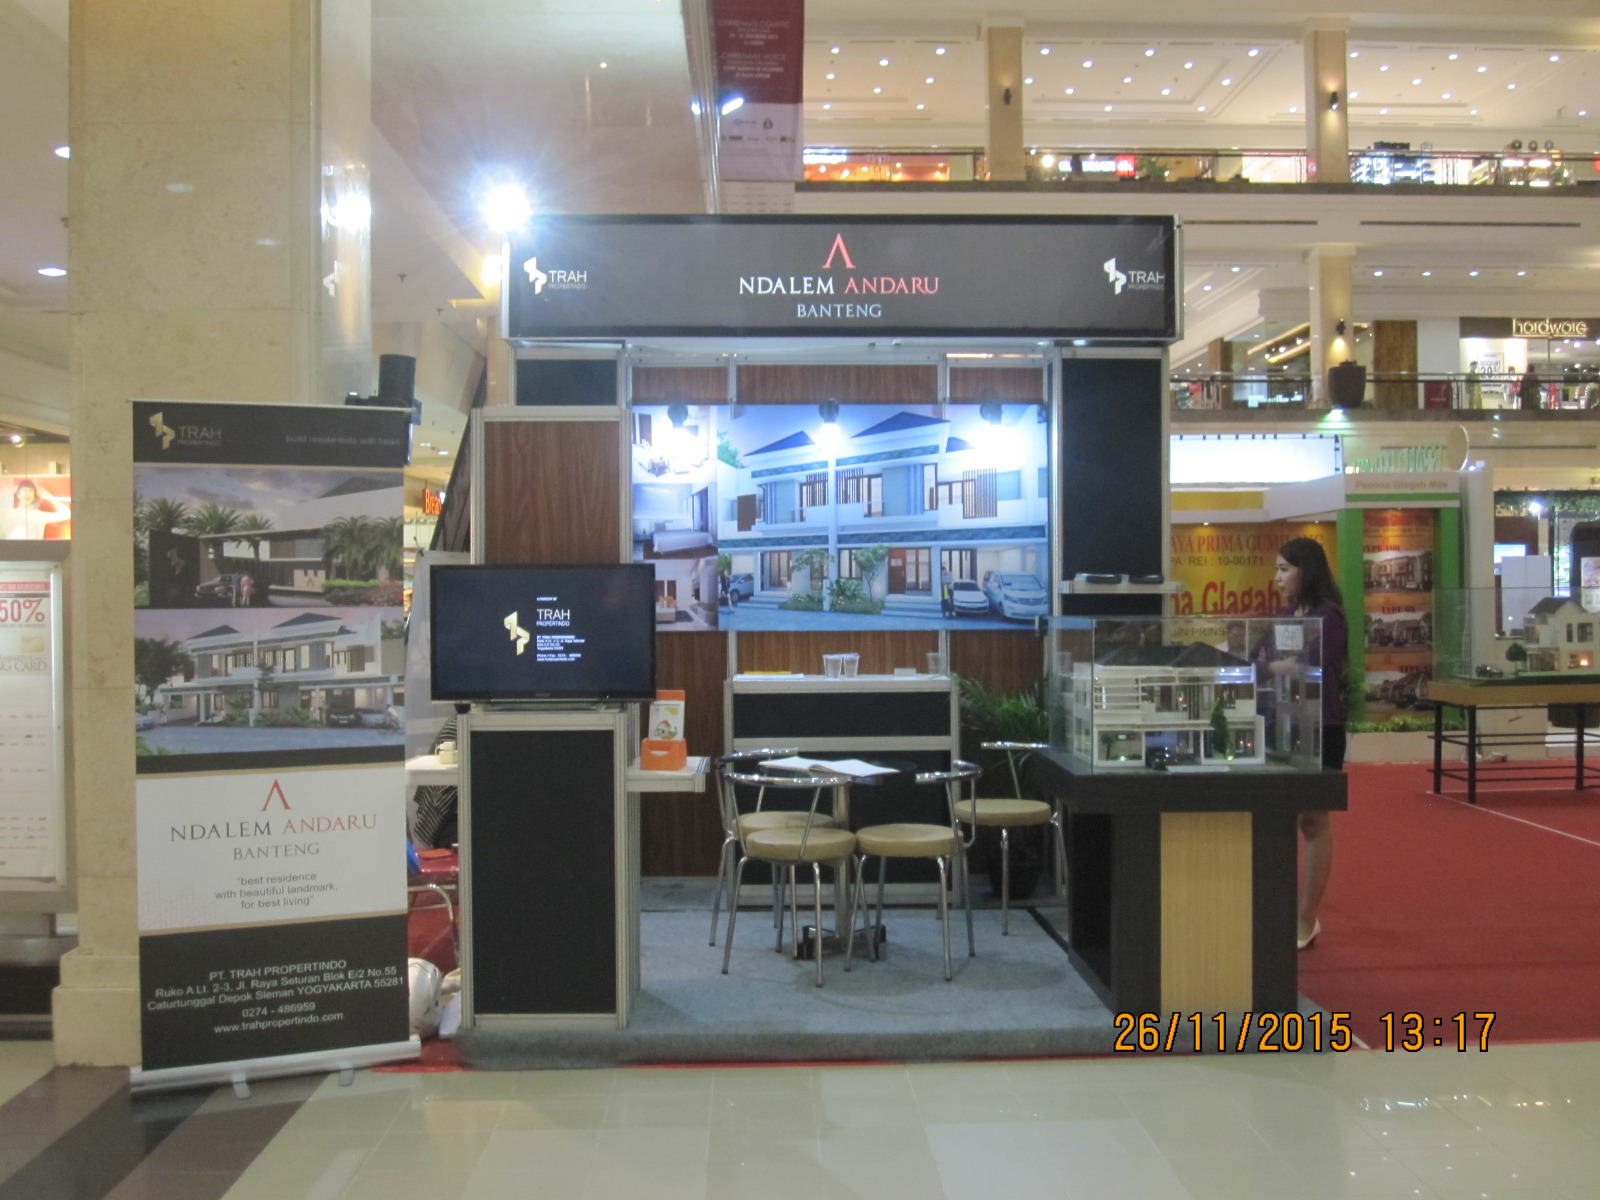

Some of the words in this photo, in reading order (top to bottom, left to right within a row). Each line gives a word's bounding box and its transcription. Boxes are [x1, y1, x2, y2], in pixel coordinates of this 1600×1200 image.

[548, 270, 587, 283] TRAH
[739, 276, 835, 295] NDALEM
[844, 276, 940, 295] ANDARU
[797, 303, 882, 318] BANTENG
[178, 425, 222, 439] TRAH
[1197, 534, 1247, 553] PRIMA
[1188, 557, 1208, 567] REI
[536, 609, 571, 621] TRAH
[171, 820, 271, 842] NDALEM
[283, 813, 377, 835] ANDARU
[233, 842, 320, 861] BANTENG
[266, 873, 317, 884] residence
[215, 889, 237, 899] with
[239, 886, 284, 898] beautiful
[241, 900, 256, 910] for
[258, 899, 280, 909] best
[230, 968, 262, 979] TRAH
[264, 960, 347, 976] PROPERTINDO
[155, 987, 184, 998] Ruko
[186, 985, 194, 995] A
[251, 979, 278, 989] Raya
[281, 975, 321, 986] Seturan
[323, 971, 345, 981] Blok
[147, 996, 216, 1010] Caturtunggal
[219, 992, 253, 1004] Depok
[255, 988, 294, 1000] Sleman
[296, 980, 372, 995] YOGYAKARTA
[374, 976, 403, 988] 55281
[242, 1007, 267, 1018] 0274
[214, 1012, 344, 1034] www.trahpropertindo.com
